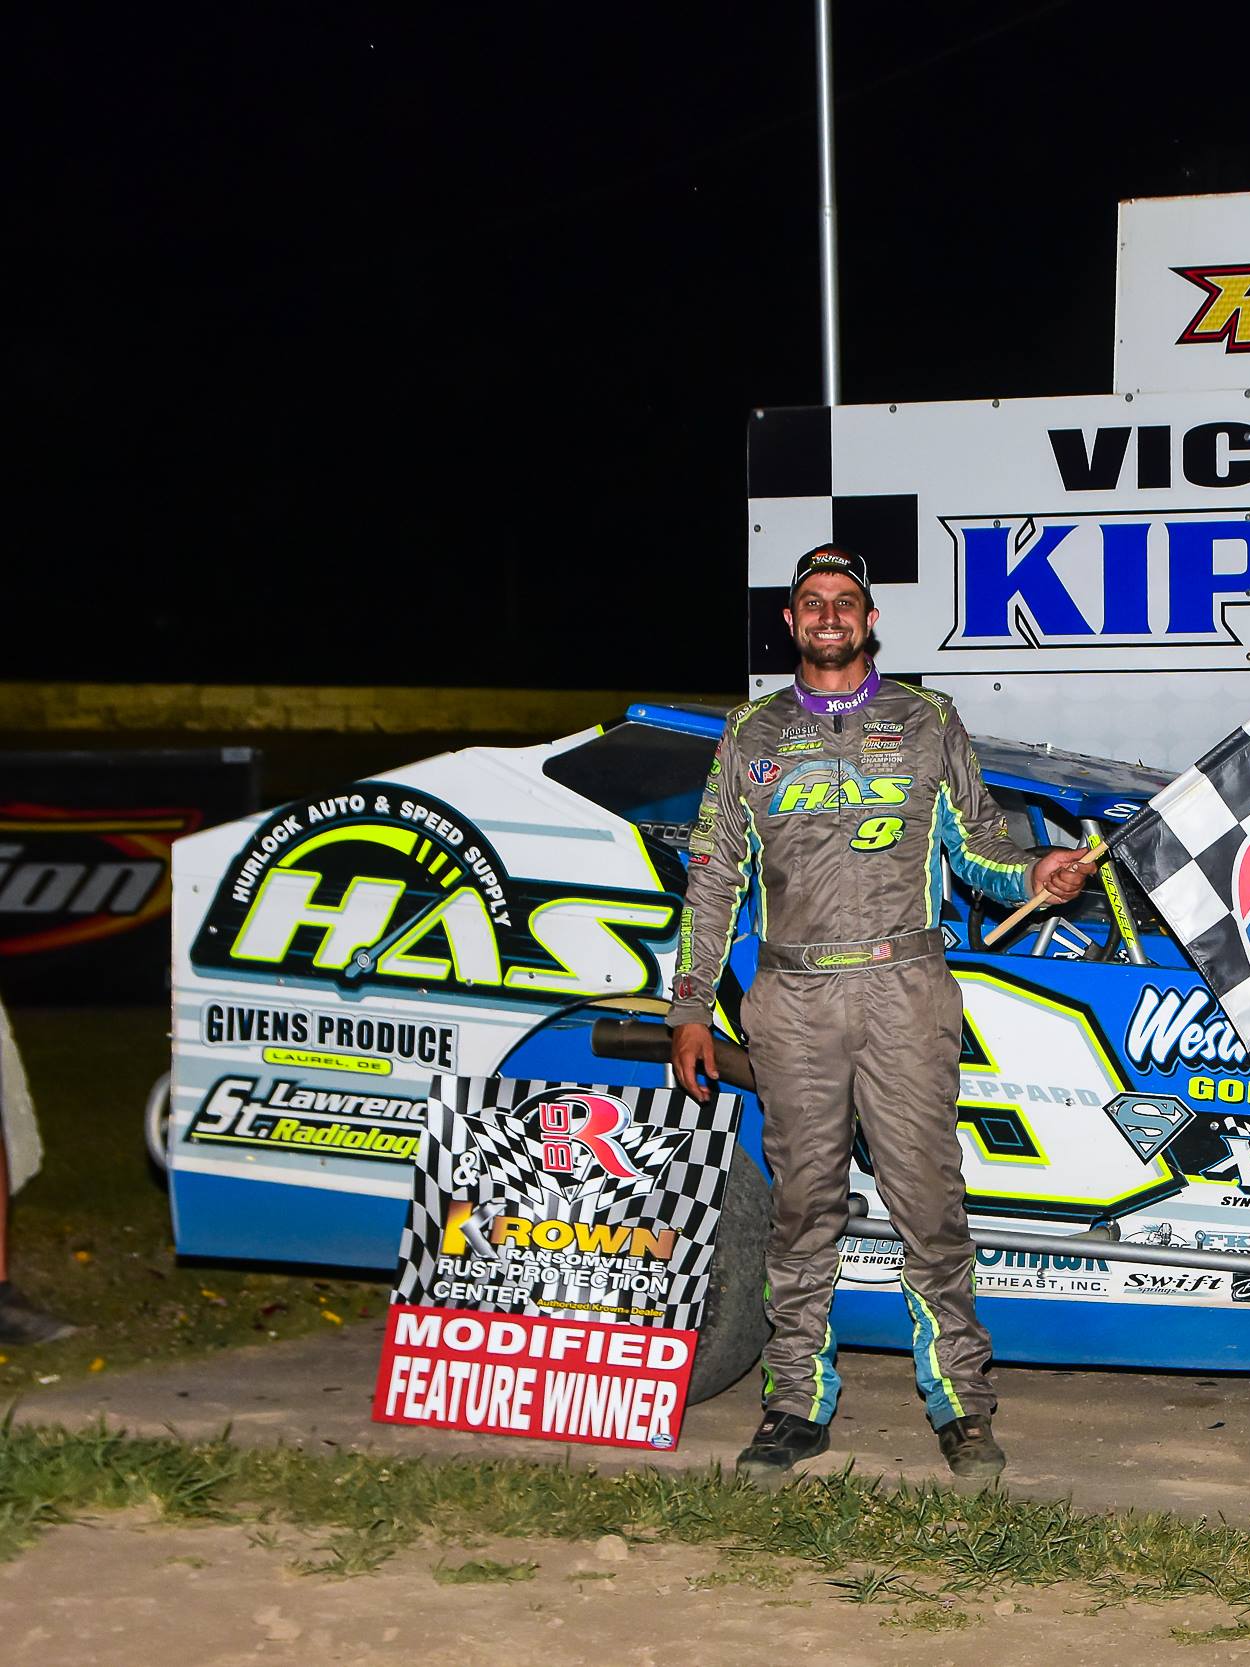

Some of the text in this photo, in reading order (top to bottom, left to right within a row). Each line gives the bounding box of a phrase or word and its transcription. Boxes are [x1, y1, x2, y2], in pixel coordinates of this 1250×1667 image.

[826, 688, 869, 713] Hoosier
[750, 759, 772, 784] VP
[779, 778, 912, 812] HAS
[850, 816, 903, 850] 9
[232, 794, 511, 927] HURLOCK AUTO & SPEED SUPPLY
[230, 869, 674, 995] HAS
[207, 1004, 452, 1069] GIVENS PRODUCE
[357, 1060, 381, 1070] DE
[195, 1078, 428, 1138] St. Lawrenc
[960, 1078, 1102, 1107] EPPARD
[270, 1119, 421, 1159] Radiolog
[538, 1094, 642, 1179] BIG R
[453, 1151, 481, 1187] &
[442, 1197, 677, 1260] KROWN
[1205, 1233, 1250, 1248] FK
[437, 1257, 669, 1295] RUST PROTECTION
[507, 1249, 665, 1275] RANSOMVILLE
[842, 1254, 904, 1265] ING SHOCKS
[433, 1281, 531, 1306] CENTER
[976, 1276, 1107, 1292] RTHEAST, INC.
[1138, 1286, 1177, 1295] springs
[537, 1298, 590, 1311] Authorized
[631, 1307, 664, 1317] Dealer
[394, 1312, 689, 1371] MODIFIED
[385, 1355, 678, 1442] FEATURE WINNER
